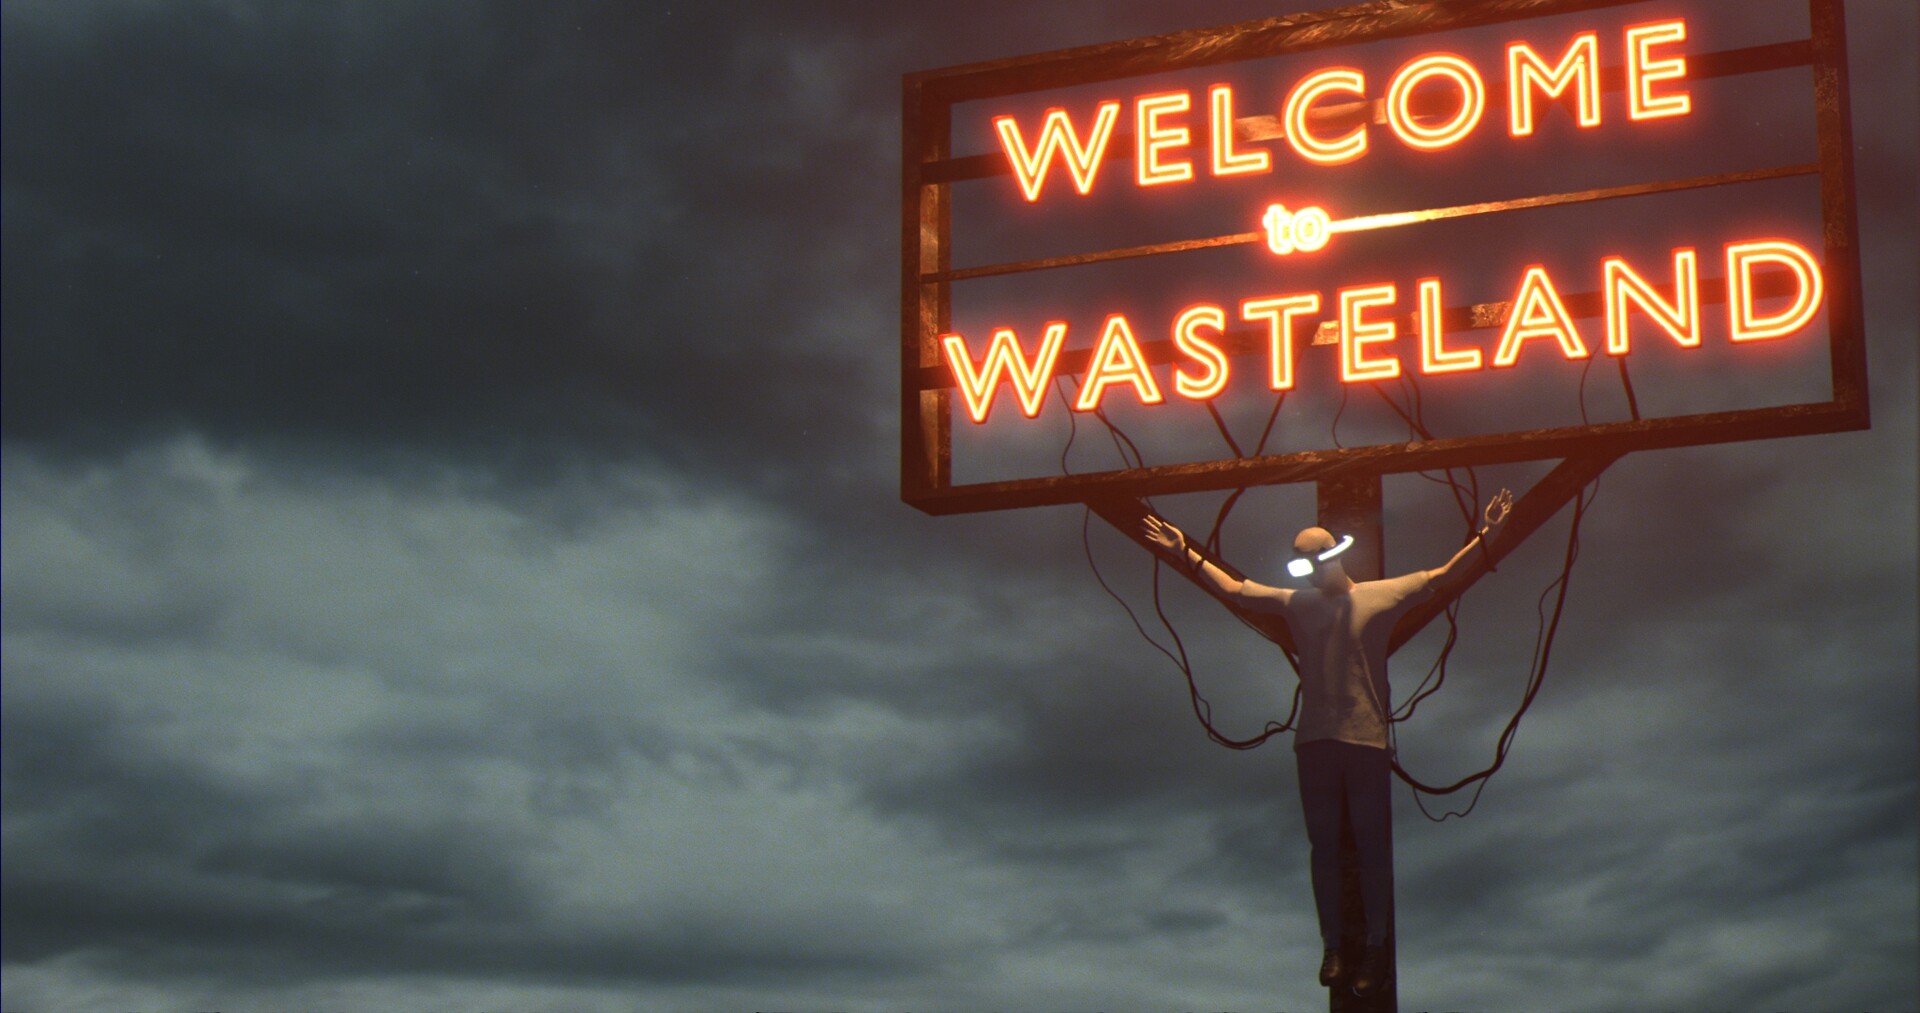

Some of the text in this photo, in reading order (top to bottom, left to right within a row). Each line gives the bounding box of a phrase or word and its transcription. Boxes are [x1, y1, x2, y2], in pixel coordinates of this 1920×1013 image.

[994, 19, 1694, 203] WELCOME
[1262, 204, 1331, 255] to
[941, 238, 1826, 424] WASTELAND
